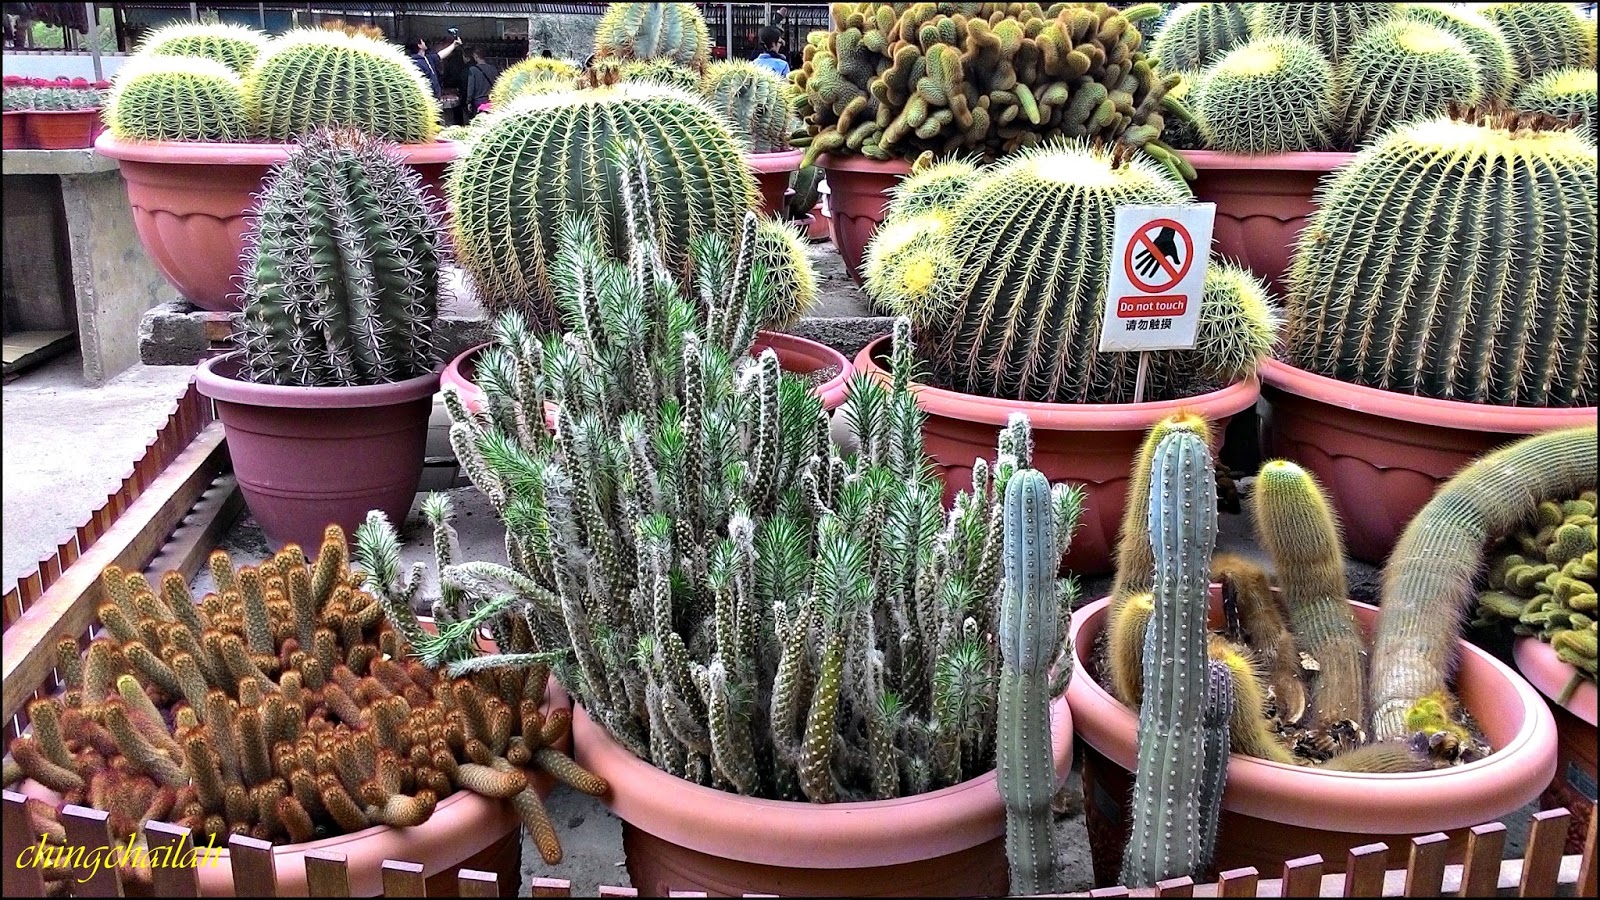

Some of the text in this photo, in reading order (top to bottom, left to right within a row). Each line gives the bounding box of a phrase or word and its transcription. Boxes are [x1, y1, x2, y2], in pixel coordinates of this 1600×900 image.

[1120, 301, 1184, 312] Do not touch
[1125, 318, 1172, 331] 请勿触摸
